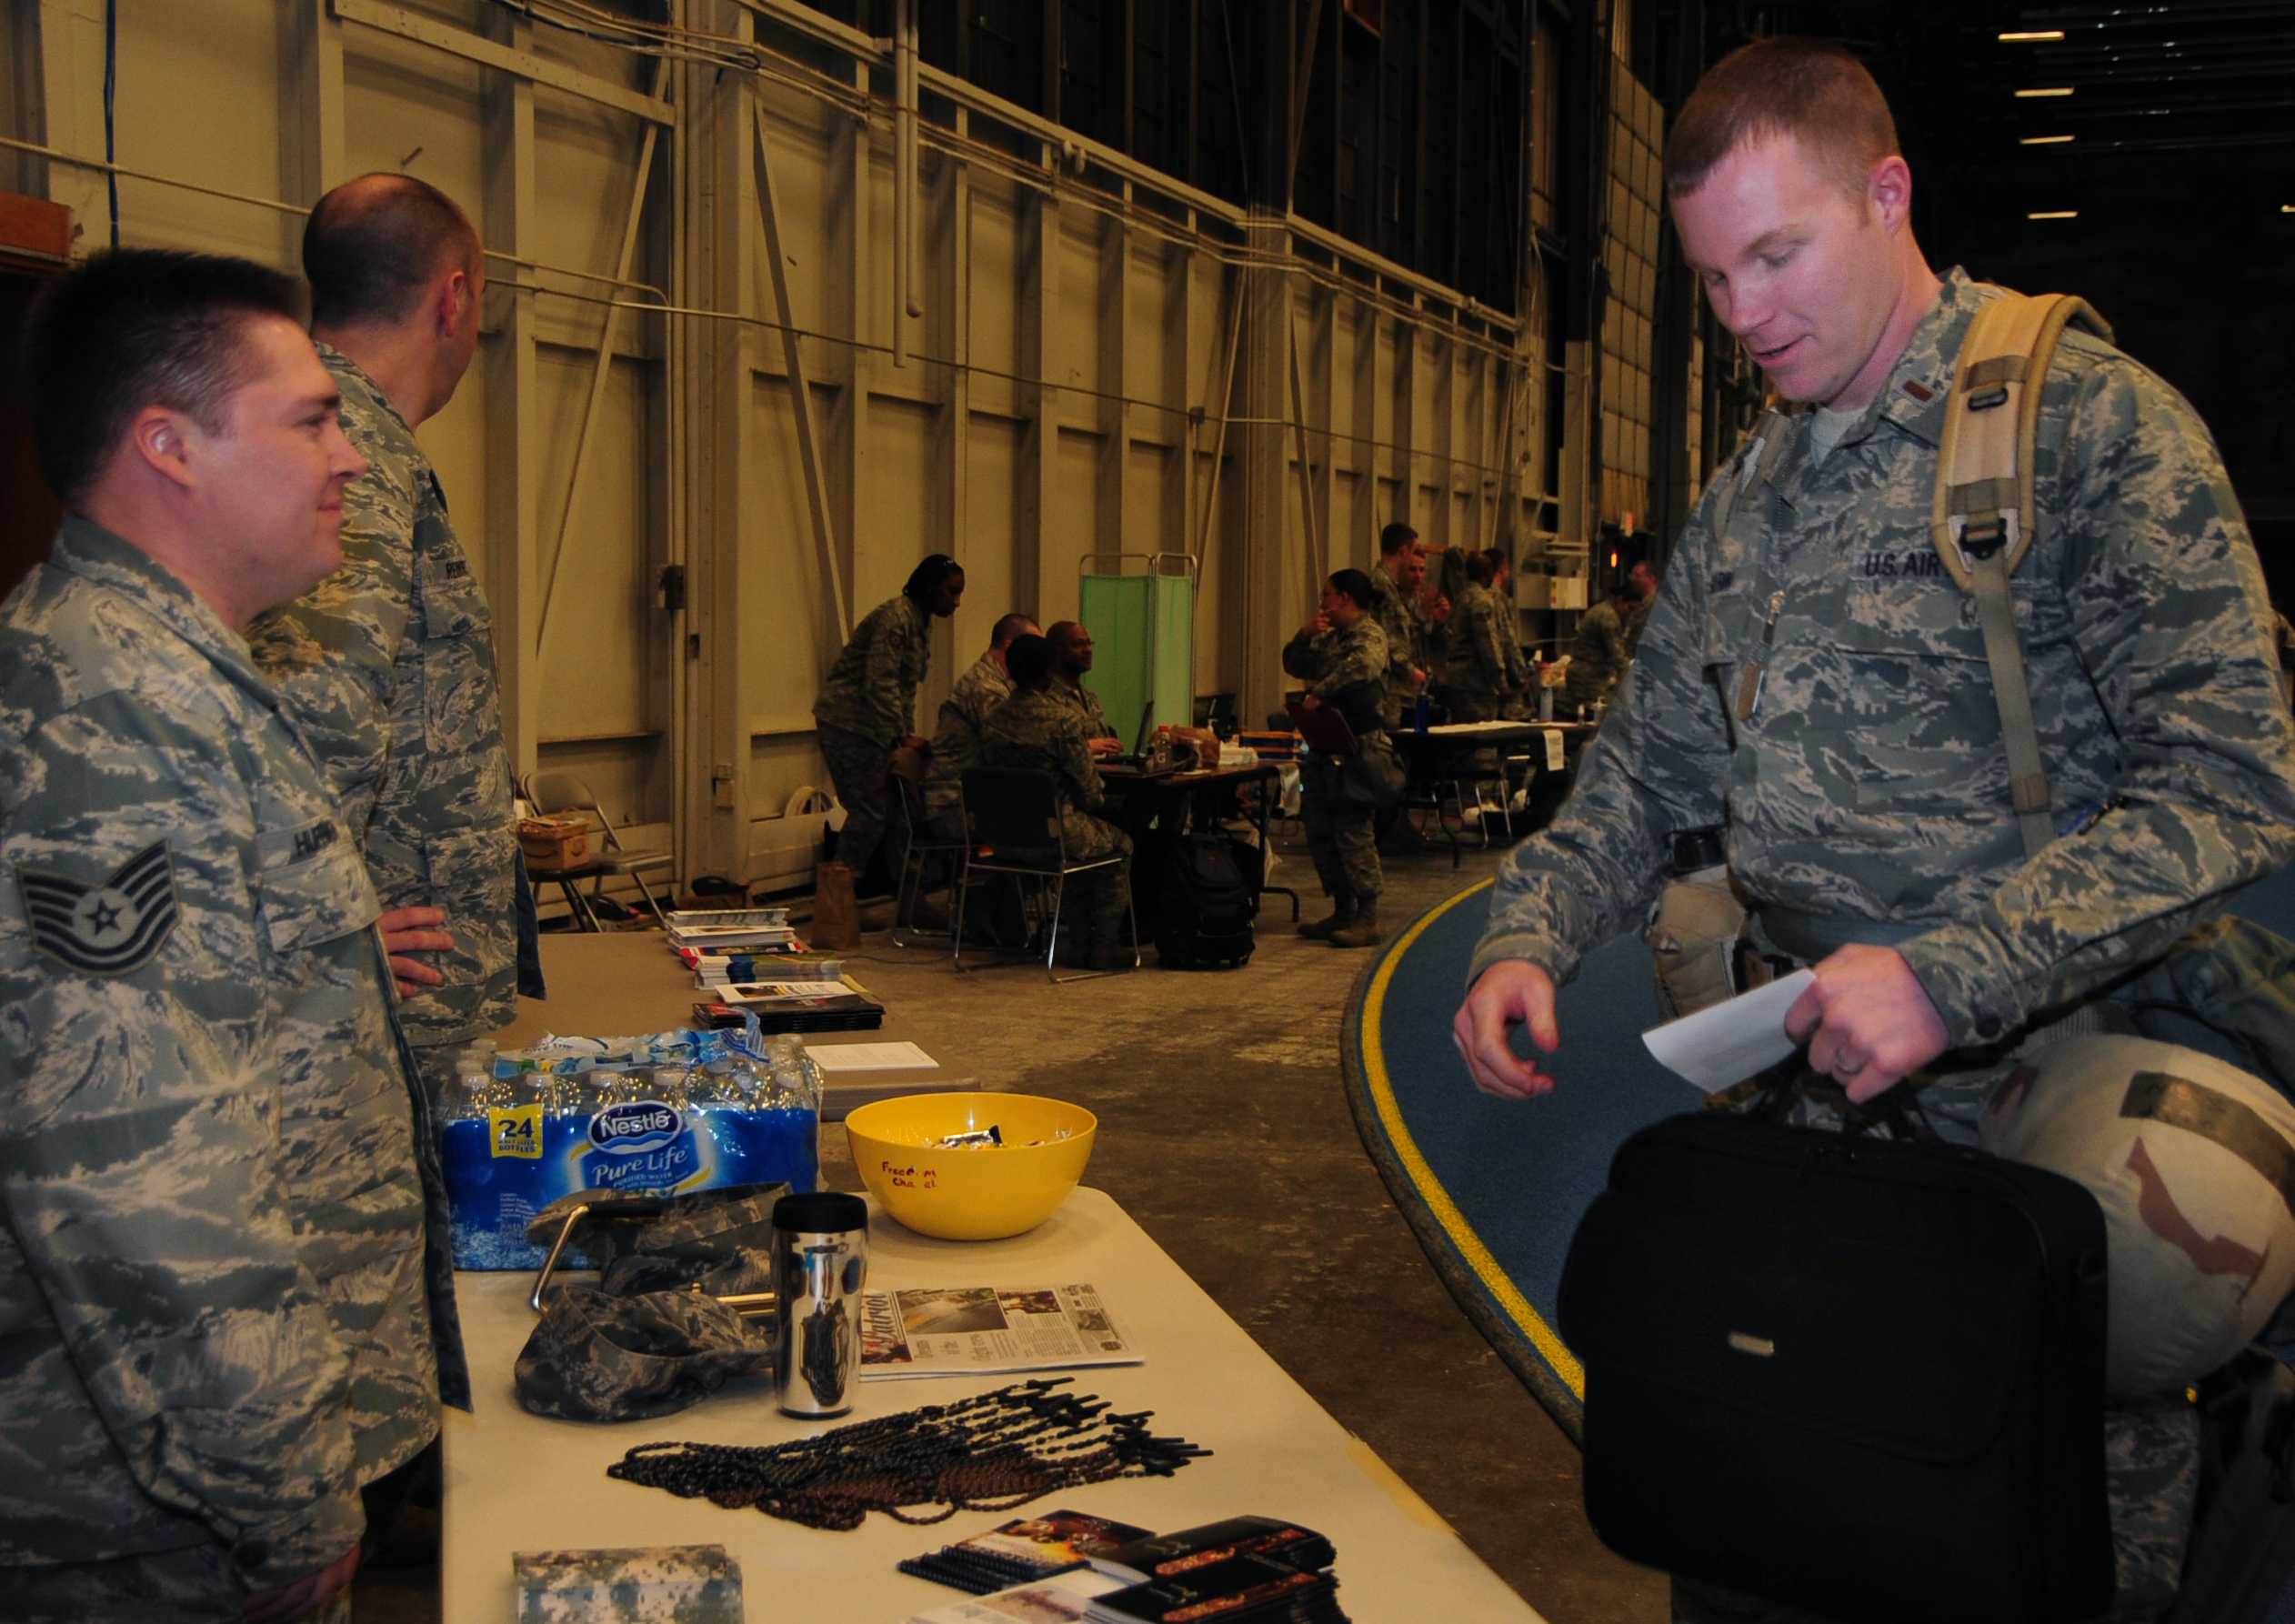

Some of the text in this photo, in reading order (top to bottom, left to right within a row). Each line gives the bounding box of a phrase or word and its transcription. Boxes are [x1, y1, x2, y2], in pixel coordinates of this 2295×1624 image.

[1902, 551, 1939, 576] AIR
[497, 1117, 535, 1138] 24
[600, 1110, 671, 1138] Nestlé
[592, 1159, 646, 1186] Pure
[647, 1146, 688, 1171] Life
